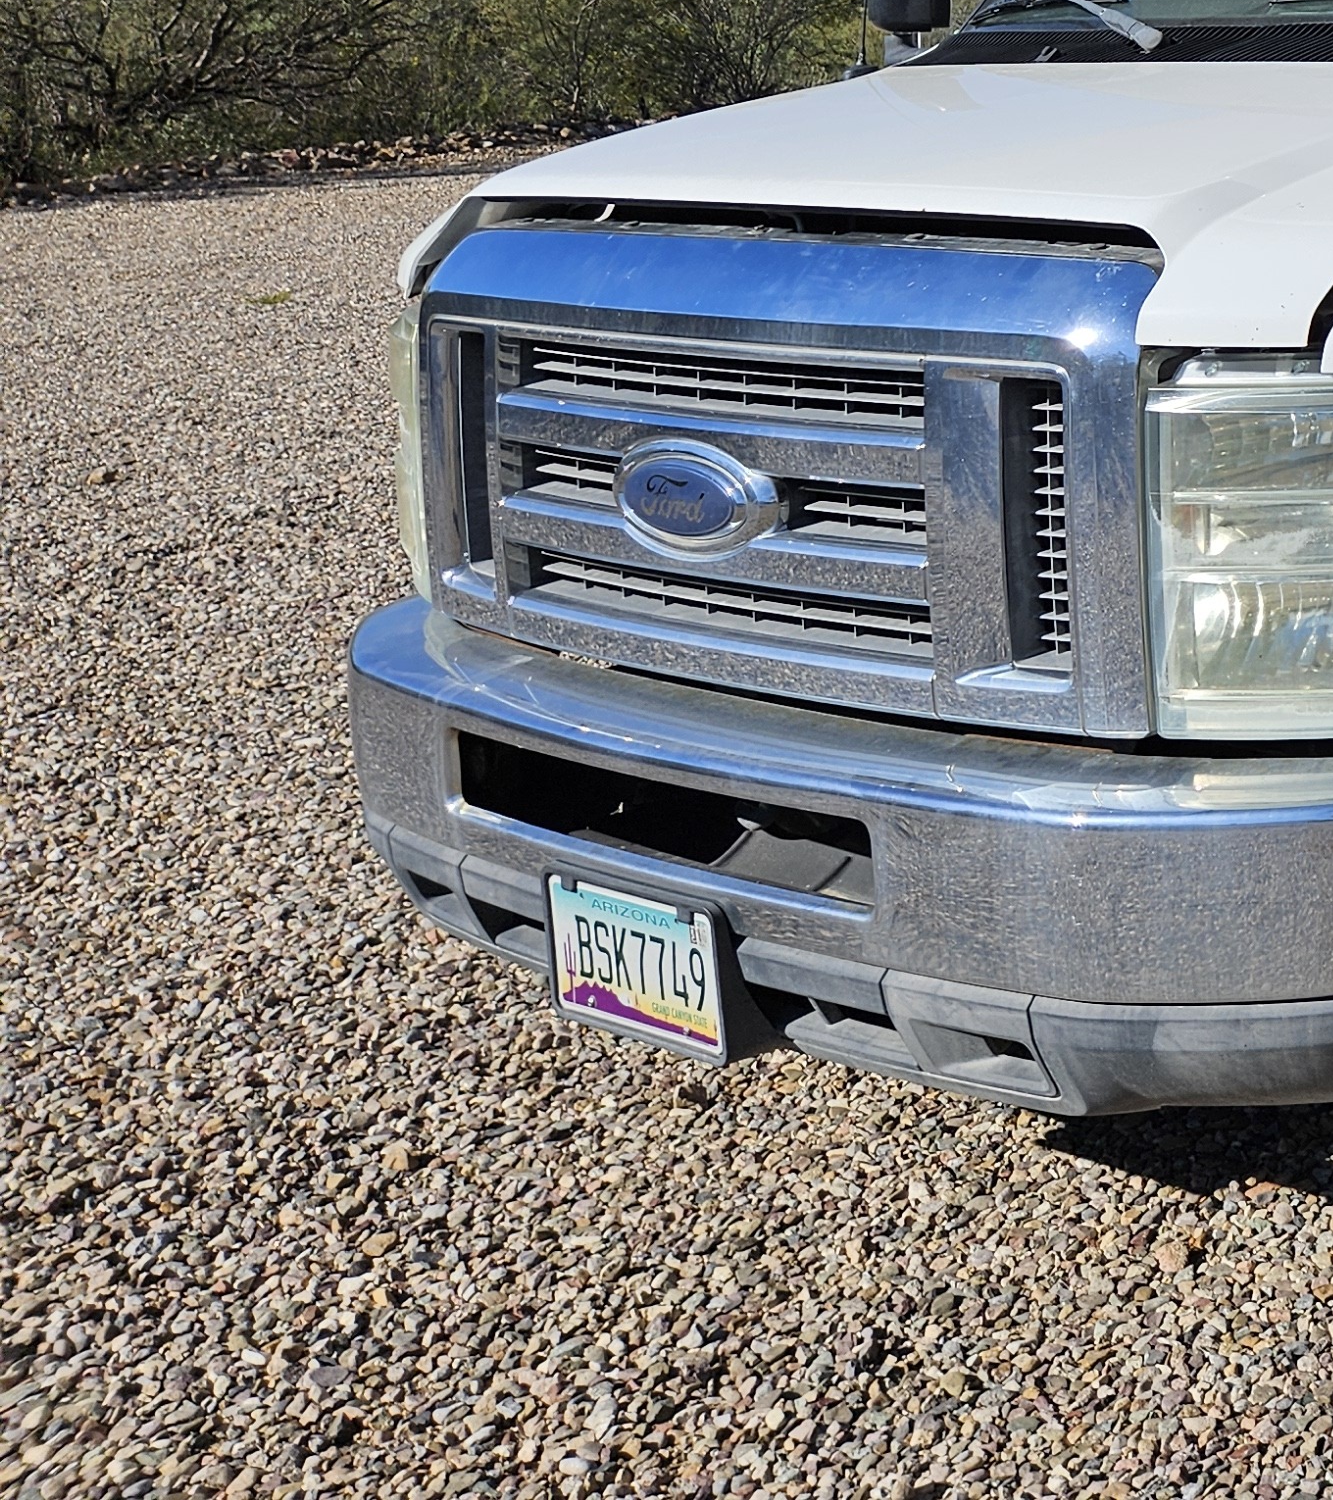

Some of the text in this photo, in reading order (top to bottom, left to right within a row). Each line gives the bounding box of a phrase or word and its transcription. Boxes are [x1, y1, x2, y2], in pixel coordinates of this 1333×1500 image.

[641, 474, 705, 523] Ford
[591, 899, 671, 929] ARIZONA
[575, 915, 706, 1012] BSK7749
[651, 1002, 708, 1029] GRAND CANYON STATE
